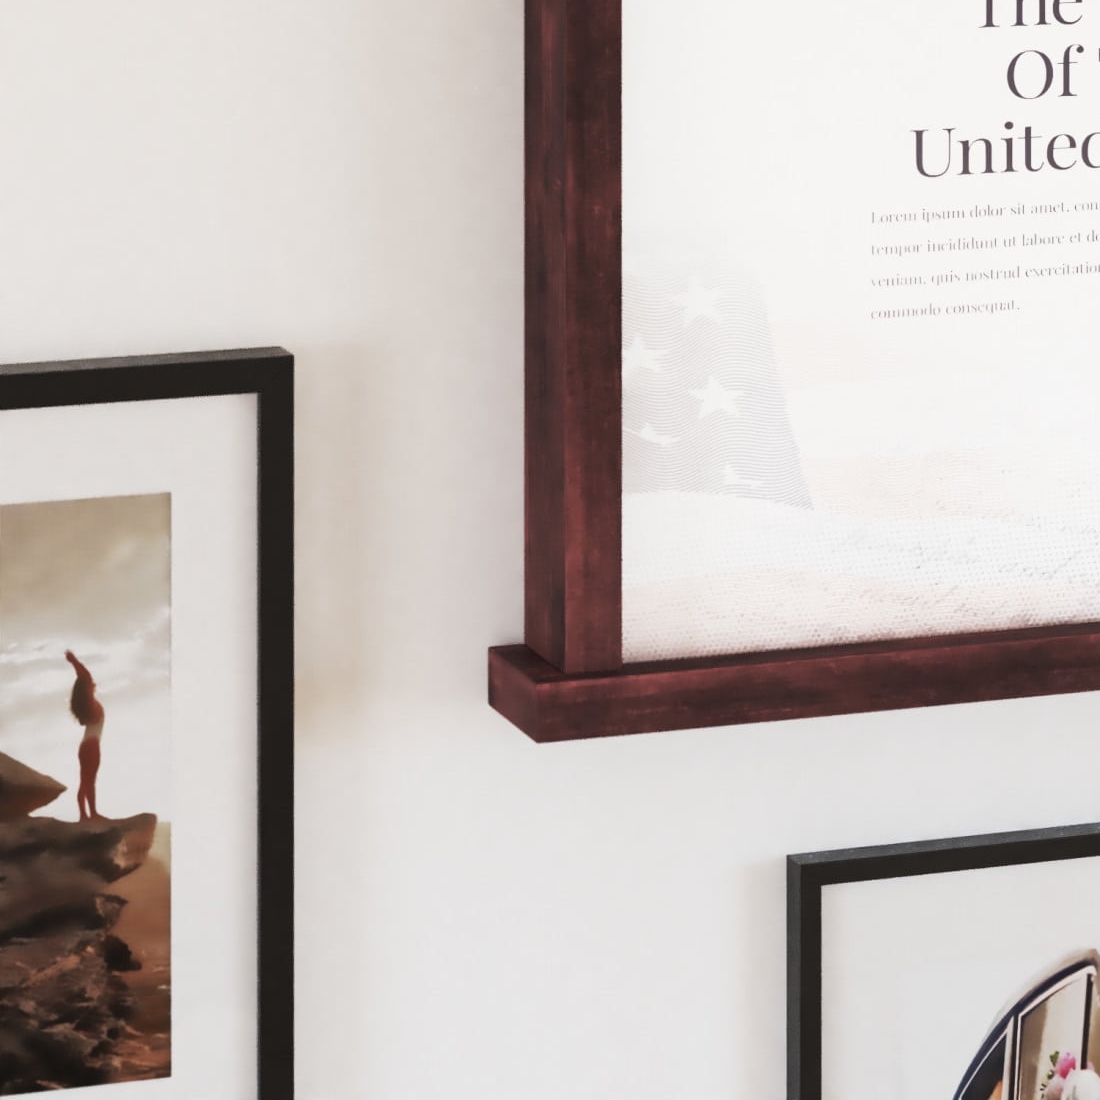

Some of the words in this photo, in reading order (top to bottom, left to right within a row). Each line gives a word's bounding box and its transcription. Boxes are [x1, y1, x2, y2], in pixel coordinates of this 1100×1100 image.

[1006, 43, 1085, 100] Of
[871, 211, 917, 224] Lorem
[921, 208, 966, 224] ipsum
[969, 204, 1007, 218] dolor
[1010, 203, 1025, 216] sit
[871, 243, 923, 257] tempor
[927, 236, 997, 253] incididunt
[1003, 235, 1016, 249] ut
[1022, 232, 1065, 247] labore
[1068, 232, 1081, 244] et
[931, 269, 961, 287] quis
[965, 265, 1021, 282] nostrud
[870, 302, 942, 320] commodo
